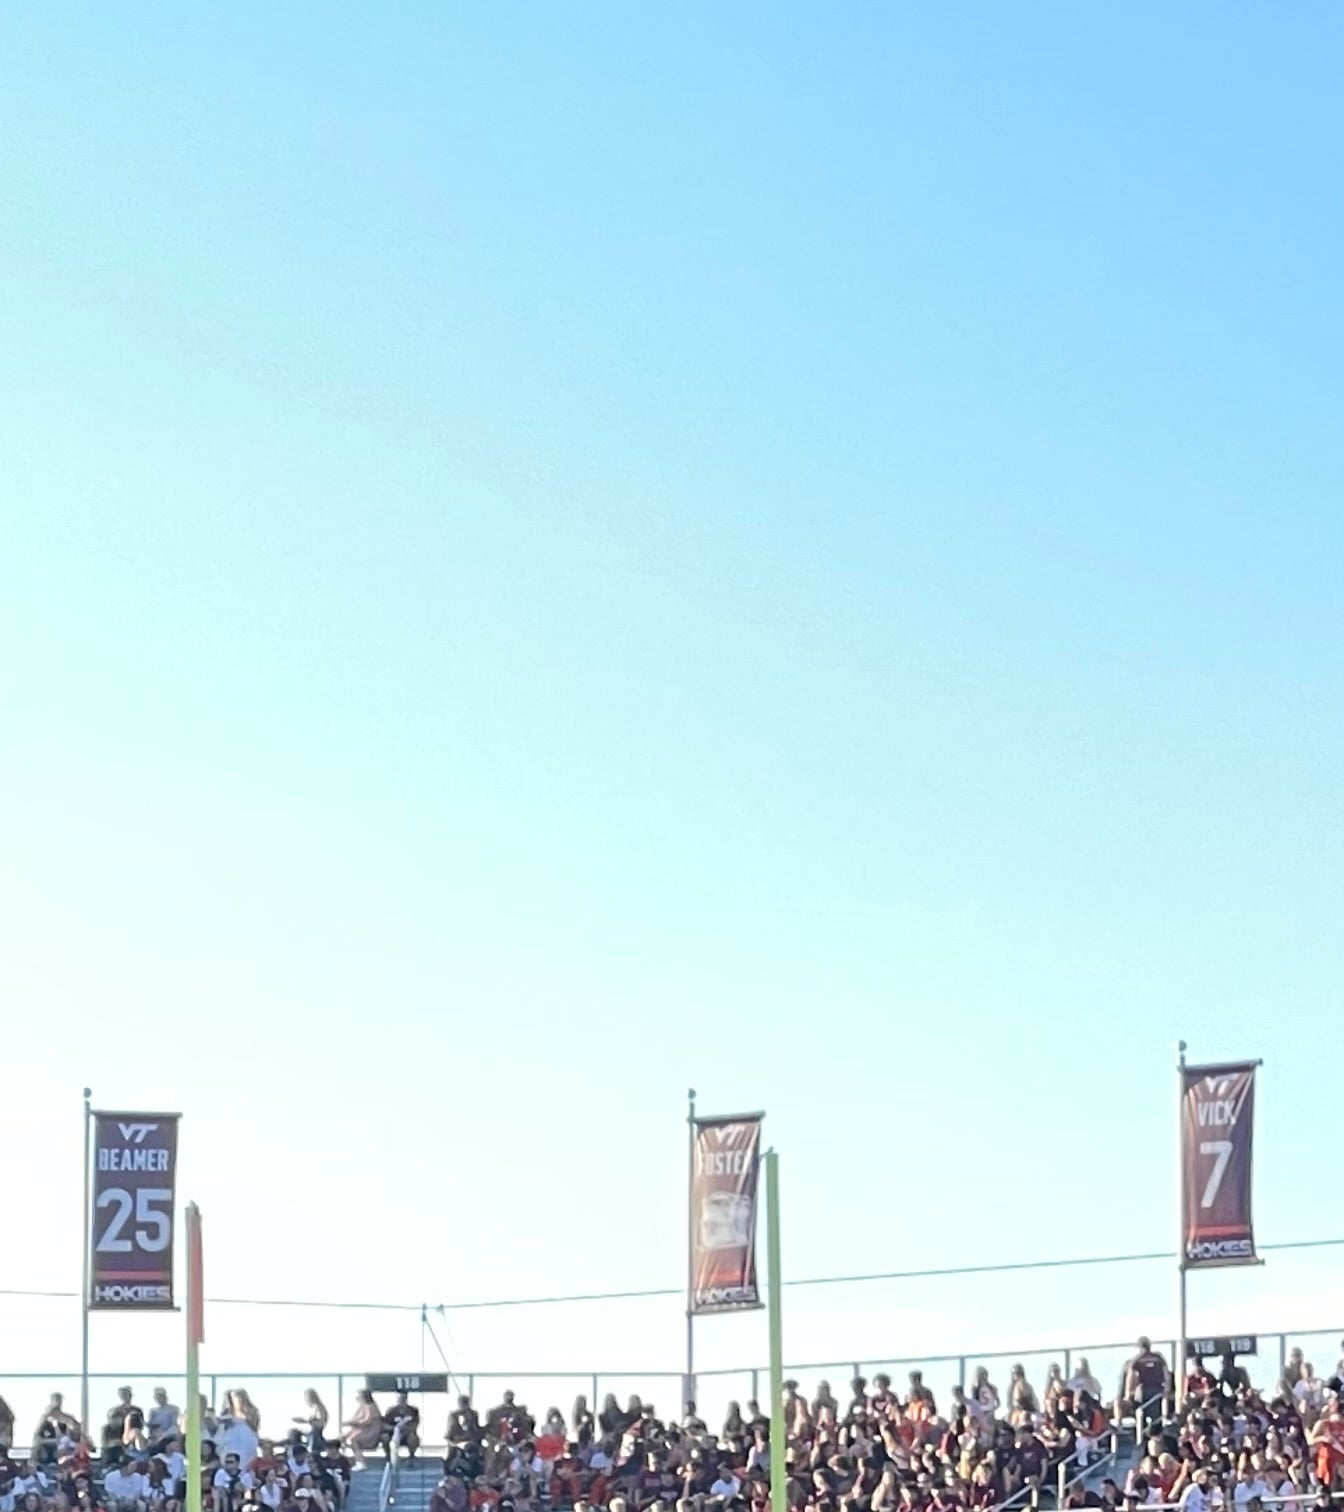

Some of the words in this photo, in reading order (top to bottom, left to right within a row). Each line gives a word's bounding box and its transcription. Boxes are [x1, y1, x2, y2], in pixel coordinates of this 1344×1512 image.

[1197, 1099, 1237, 1126] VICK
[118, 1123, 158, 1143] VT
[98, 1148, 169, 1171] BEAMER
[1200, 1140, 1233, 1208] 7
[96, 1188, 172, 1252] 25
[1186, 1240, 1251, 1258] HOKIES
[95, 1285, 171, 1302] HOKIES
